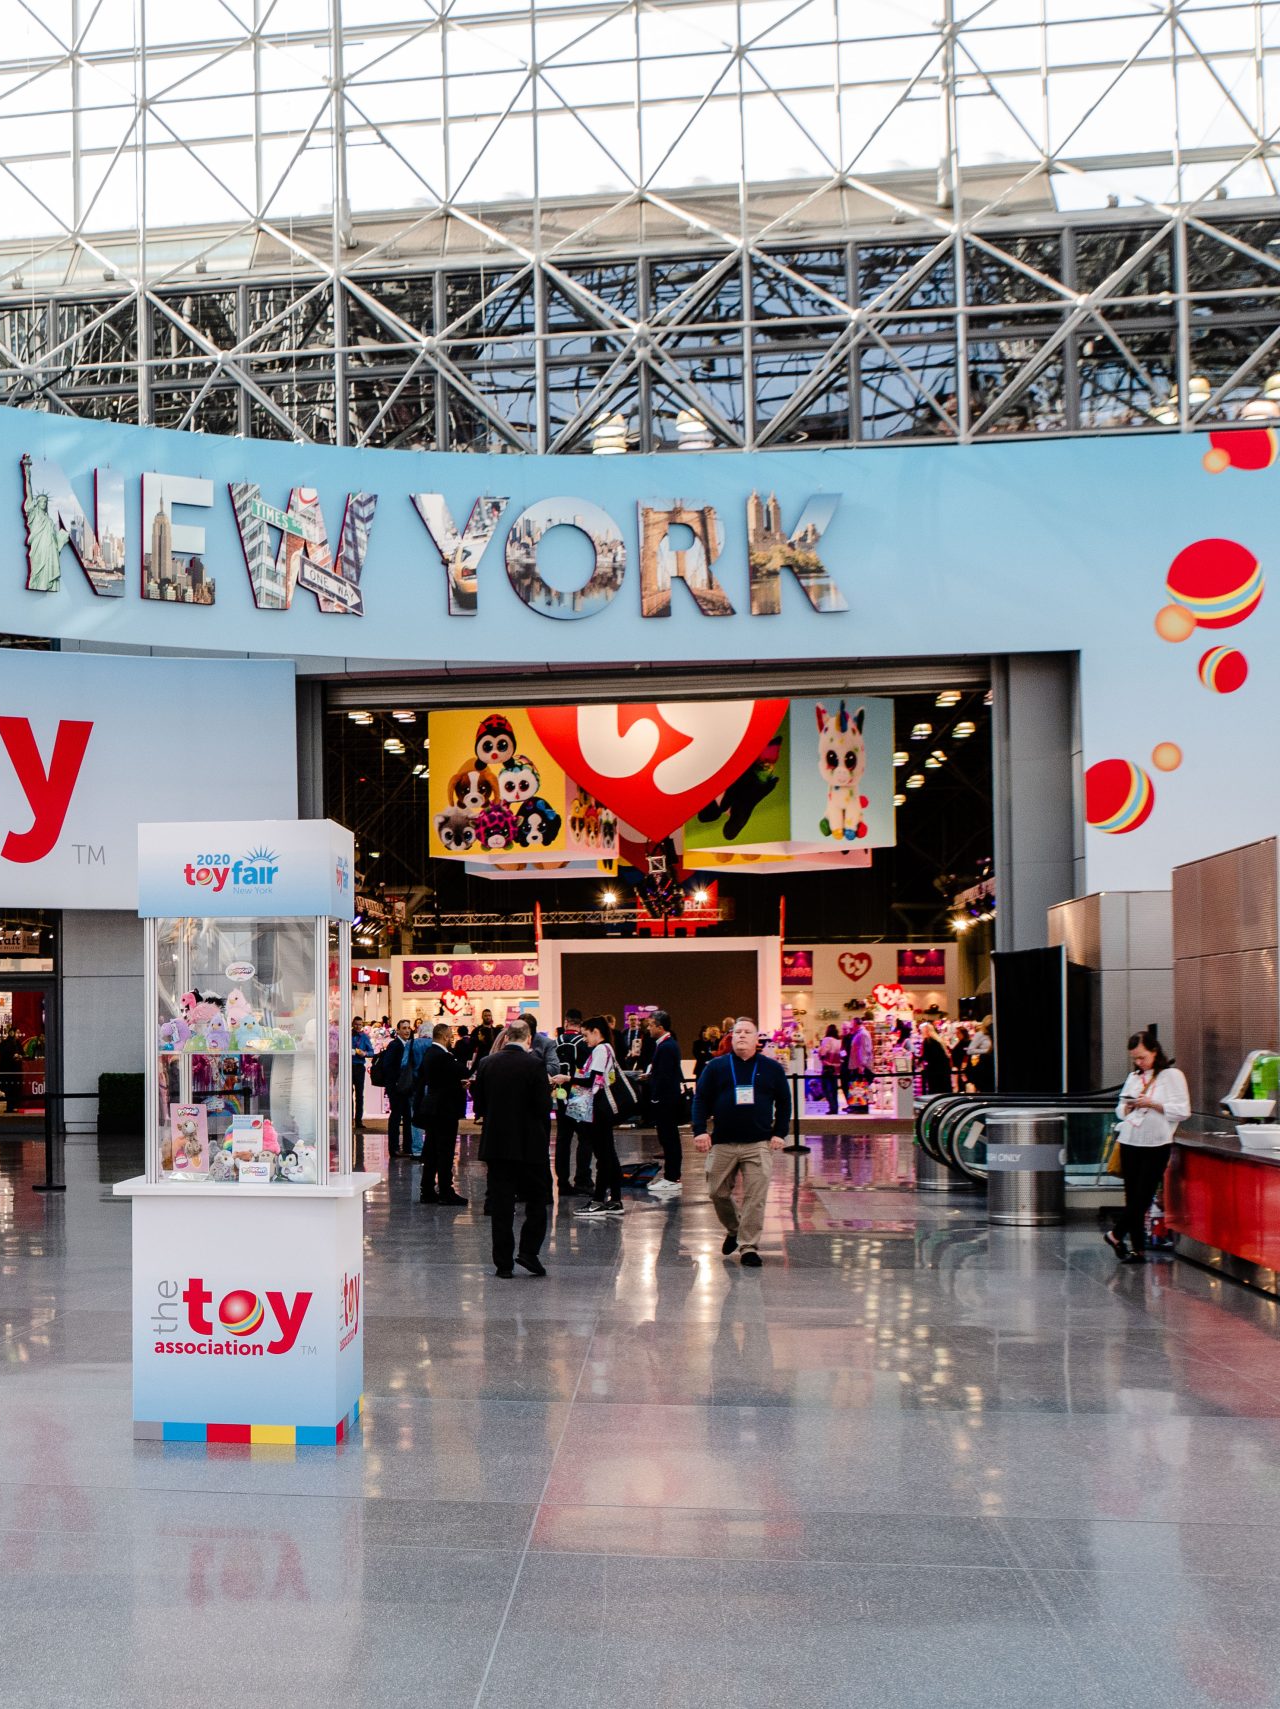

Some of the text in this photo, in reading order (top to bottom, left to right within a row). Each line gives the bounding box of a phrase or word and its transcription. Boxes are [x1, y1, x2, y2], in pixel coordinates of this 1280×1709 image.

[252, 501, 289, 529] TIMES
[21, 453, 378, 616] NEW
[409, 490, 850, 620] YORK
[309, 569, 355, 603] ONE WAY
[72, 844, 106, 865] TM
[196, 854, 230, 865] 2020
[233, 886, 273, 895] New York
[840, 954, 869, 977] ty
[452, 974, 526, 991] FASHION
[443, 991, 467, 1011] ty
[873, 984, 901, 1005] ty
[151, 1280, 178, 1335] the
[182, 1278, 313, 1354] toy
[154, 1339, 264, 1356] association
[300, 1345, 318, 1355] TM
